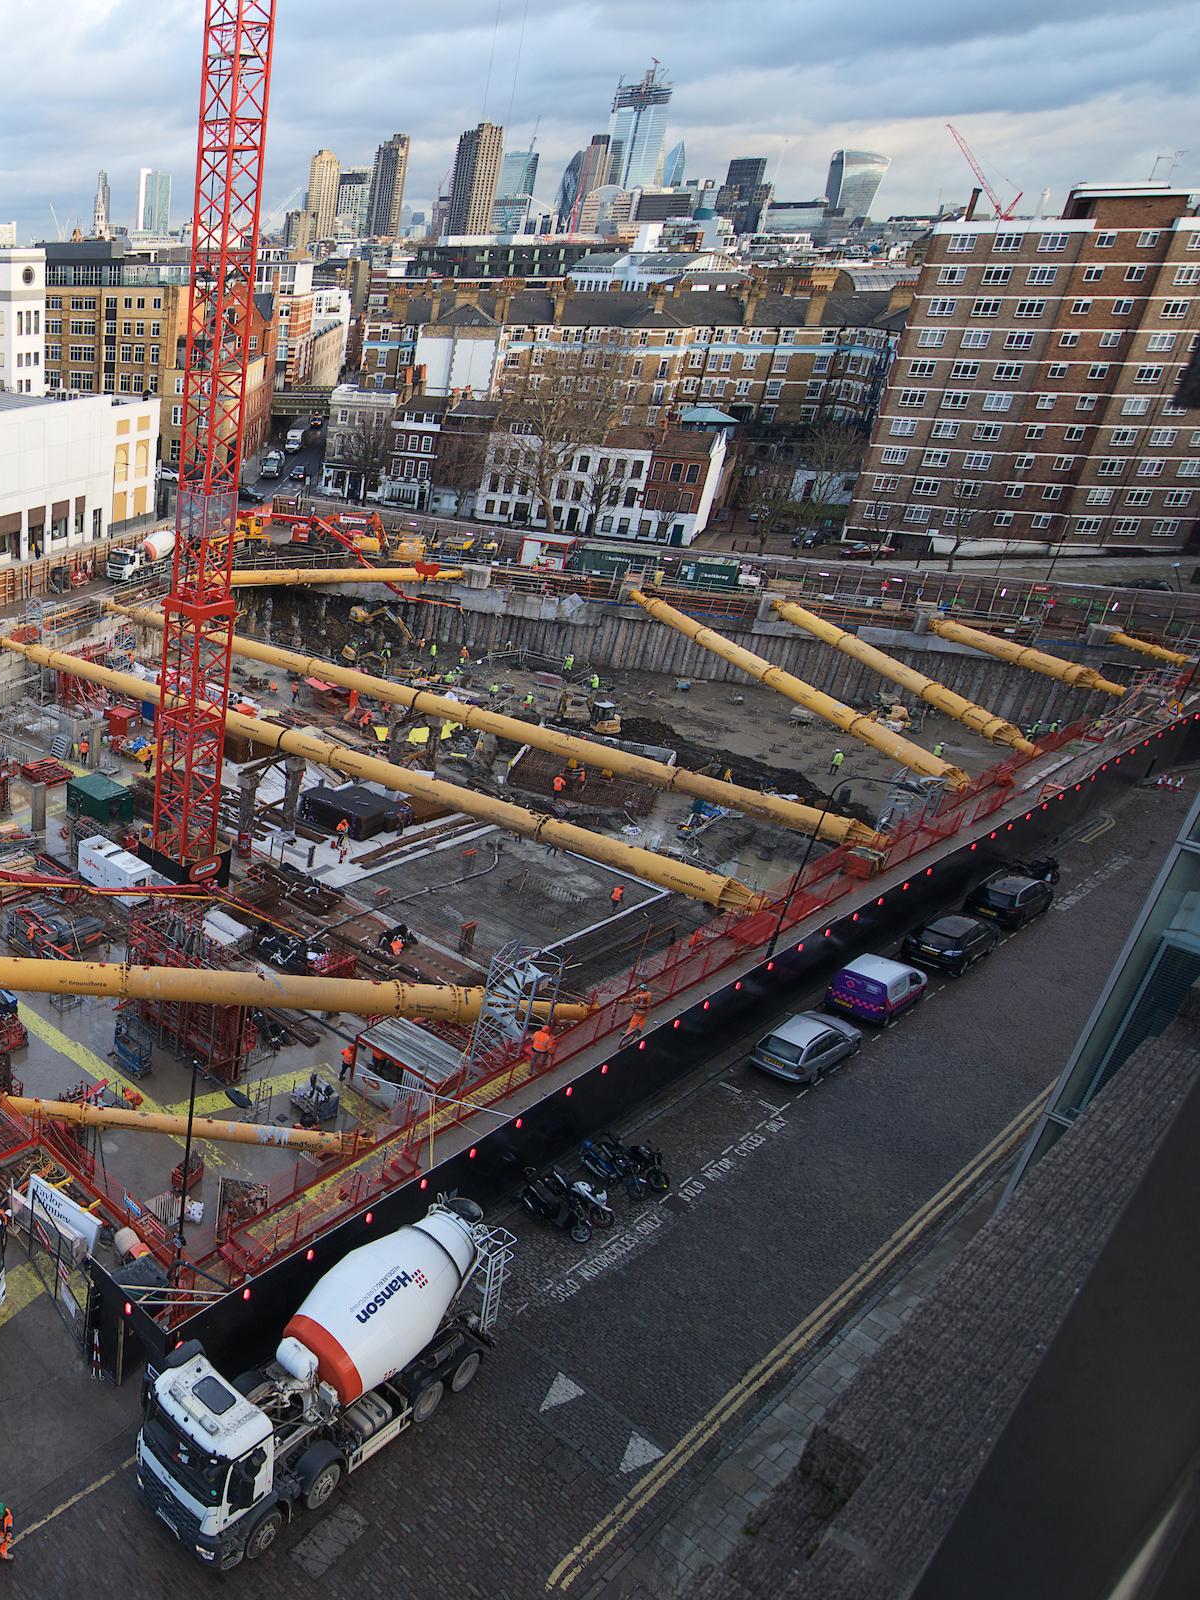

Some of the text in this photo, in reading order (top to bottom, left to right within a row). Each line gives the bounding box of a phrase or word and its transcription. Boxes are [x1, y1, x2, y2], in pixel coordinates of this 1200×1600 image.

[704, 572, 730, 581] keltbray
[670, 875, 706, 892] Groundforce
[68, 980, 108, 988] Groundforce
[416, 1003, 449, 1012] Groundforce
[677, 1114, 789, 1202] SOLO MOTOR CYCLES ONLY
[34, 1183, 63, 1209] Taylor
[576, 1233, 639, 1282] MOTORCYCLES
[636, 1212, 664, 1236] ONLY
[355, 1270, 413, 1324] Hanson
